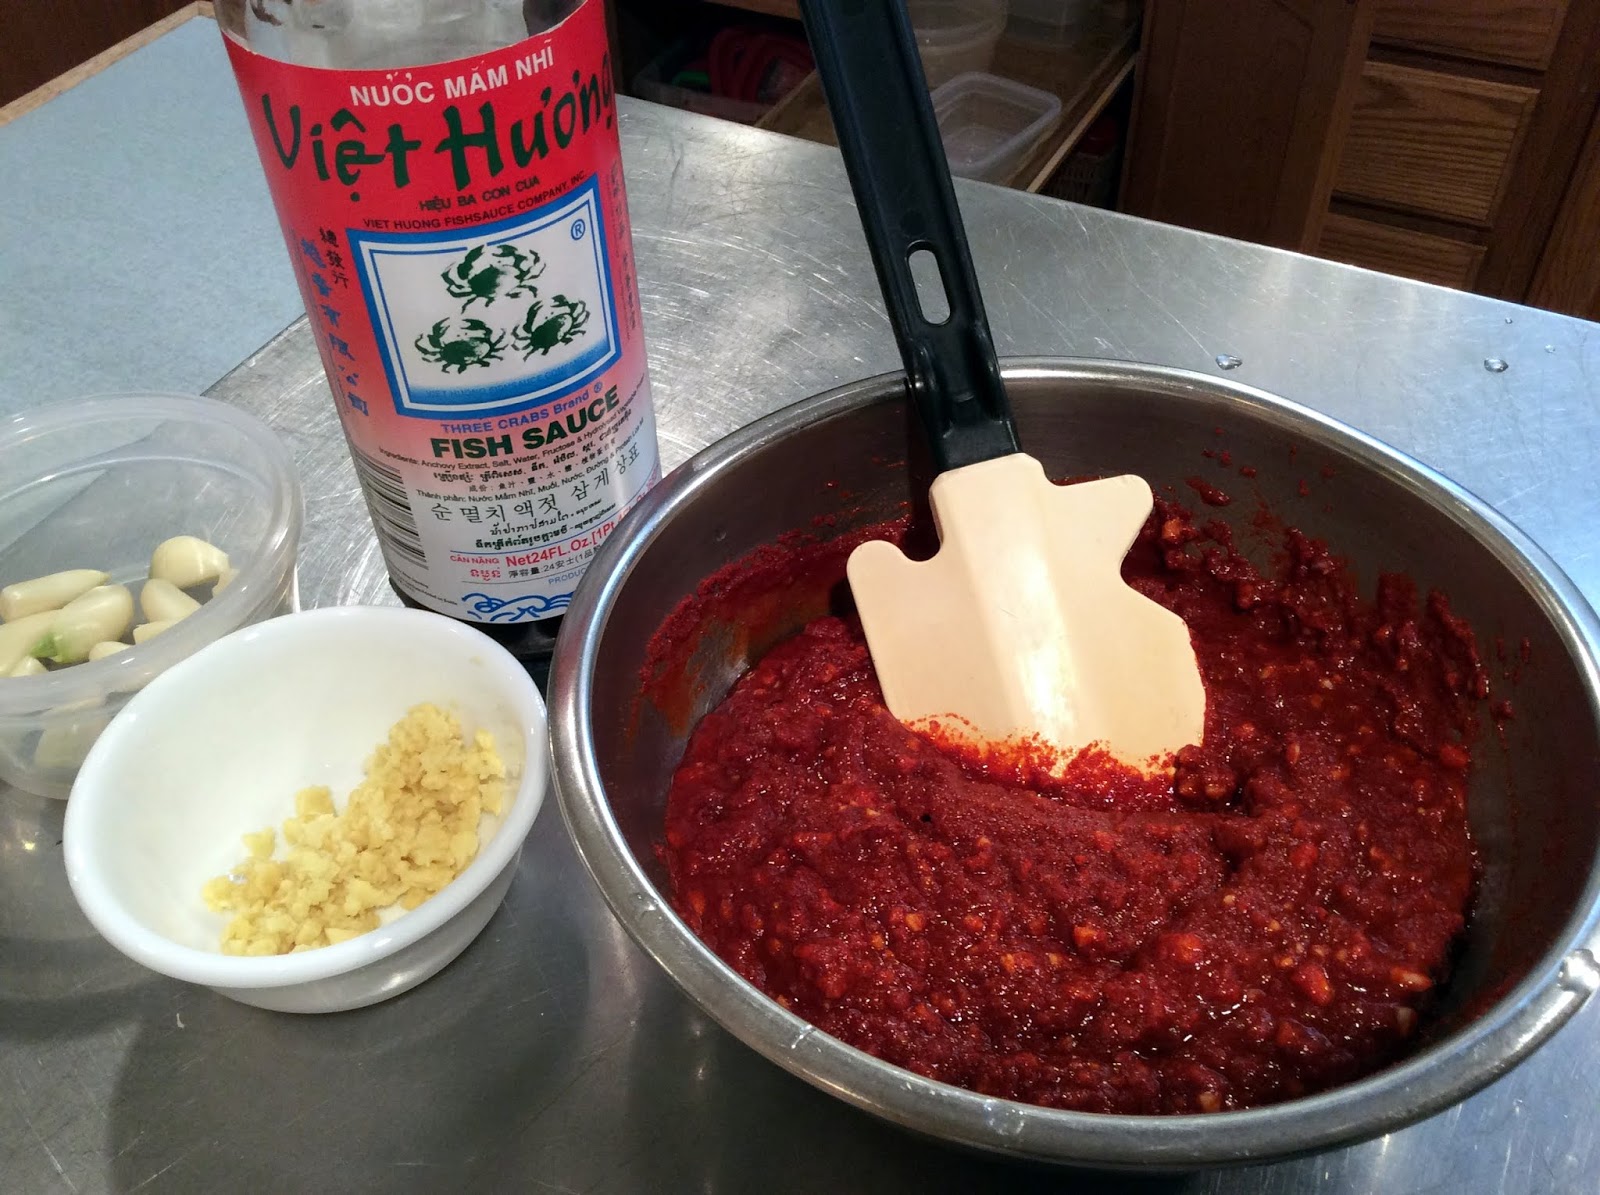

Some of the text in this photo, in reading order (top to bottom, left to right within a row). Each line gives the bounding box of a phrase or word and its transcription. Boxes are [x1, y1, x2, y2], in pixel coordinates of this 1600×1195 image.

[262, 52, 612, 202] Việt Hương
[457, 193, 477, 207] BA
[482, 187, 510, 202] CON
[515, 175, 540, 192] CUA
[363, 217, 389, 229] VIET
[394, 218, 440, 230] HUONG
[445, 204, 515, 226] FISHSAUCE
[430, 434, 513, 459] FISH
[522, 384, 620, 450] SAUCE
[441, 421, 493, 433] THREE
[498, 408, 549, 429] CRABS
[553, 391, 590, 415] Brand
[421, 460, 456, 470] Anchovy
[542, 440, 575, 458] Fructose
[548, 567, 587, 585] PRODUC
